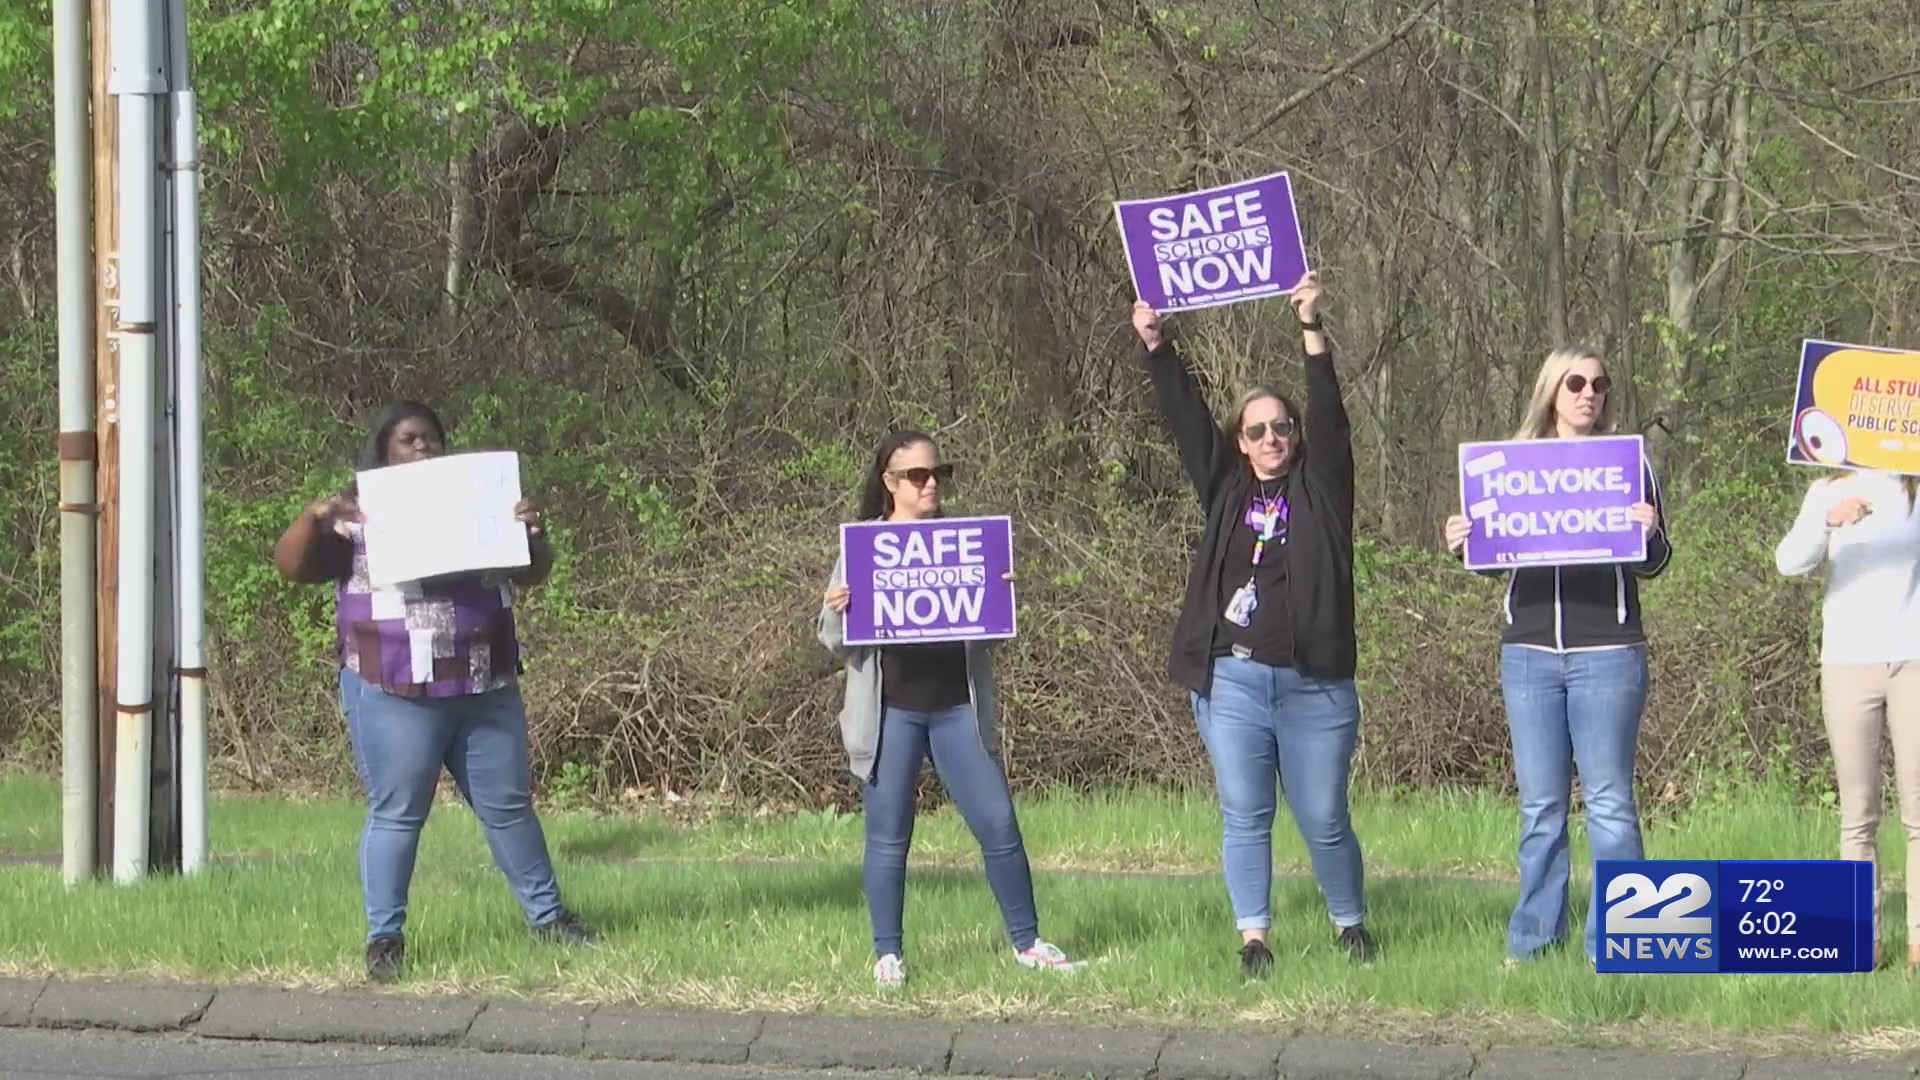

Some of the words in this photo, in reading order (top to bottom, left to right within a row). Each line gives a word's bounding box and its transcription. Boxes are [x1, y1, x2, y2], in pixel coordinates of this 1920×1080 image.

[1148, 189, 1267, 241] SAFE
[1156, 227, 1270, 262] SCHOOLS
[1158, 245, 1273, 297] NOW
[1853, 376, 1882, 394] ALL
[1886, 380, 1920, 398] STU
[1850, 393, 1915, 418] DESERVE
[1848, 414, 1897, 433] PUBLIC
[1900, 420, 1920, 436] SC
[1482, 466, 1632, 498] HOLYOKE,
[1484, 506, 1633, 539] HOLYOKE!
[873, 528, 985, 568] SAFE
[874, 567, 985, 589] SCHOOLS
[873, 587, 986, 626] NOW
